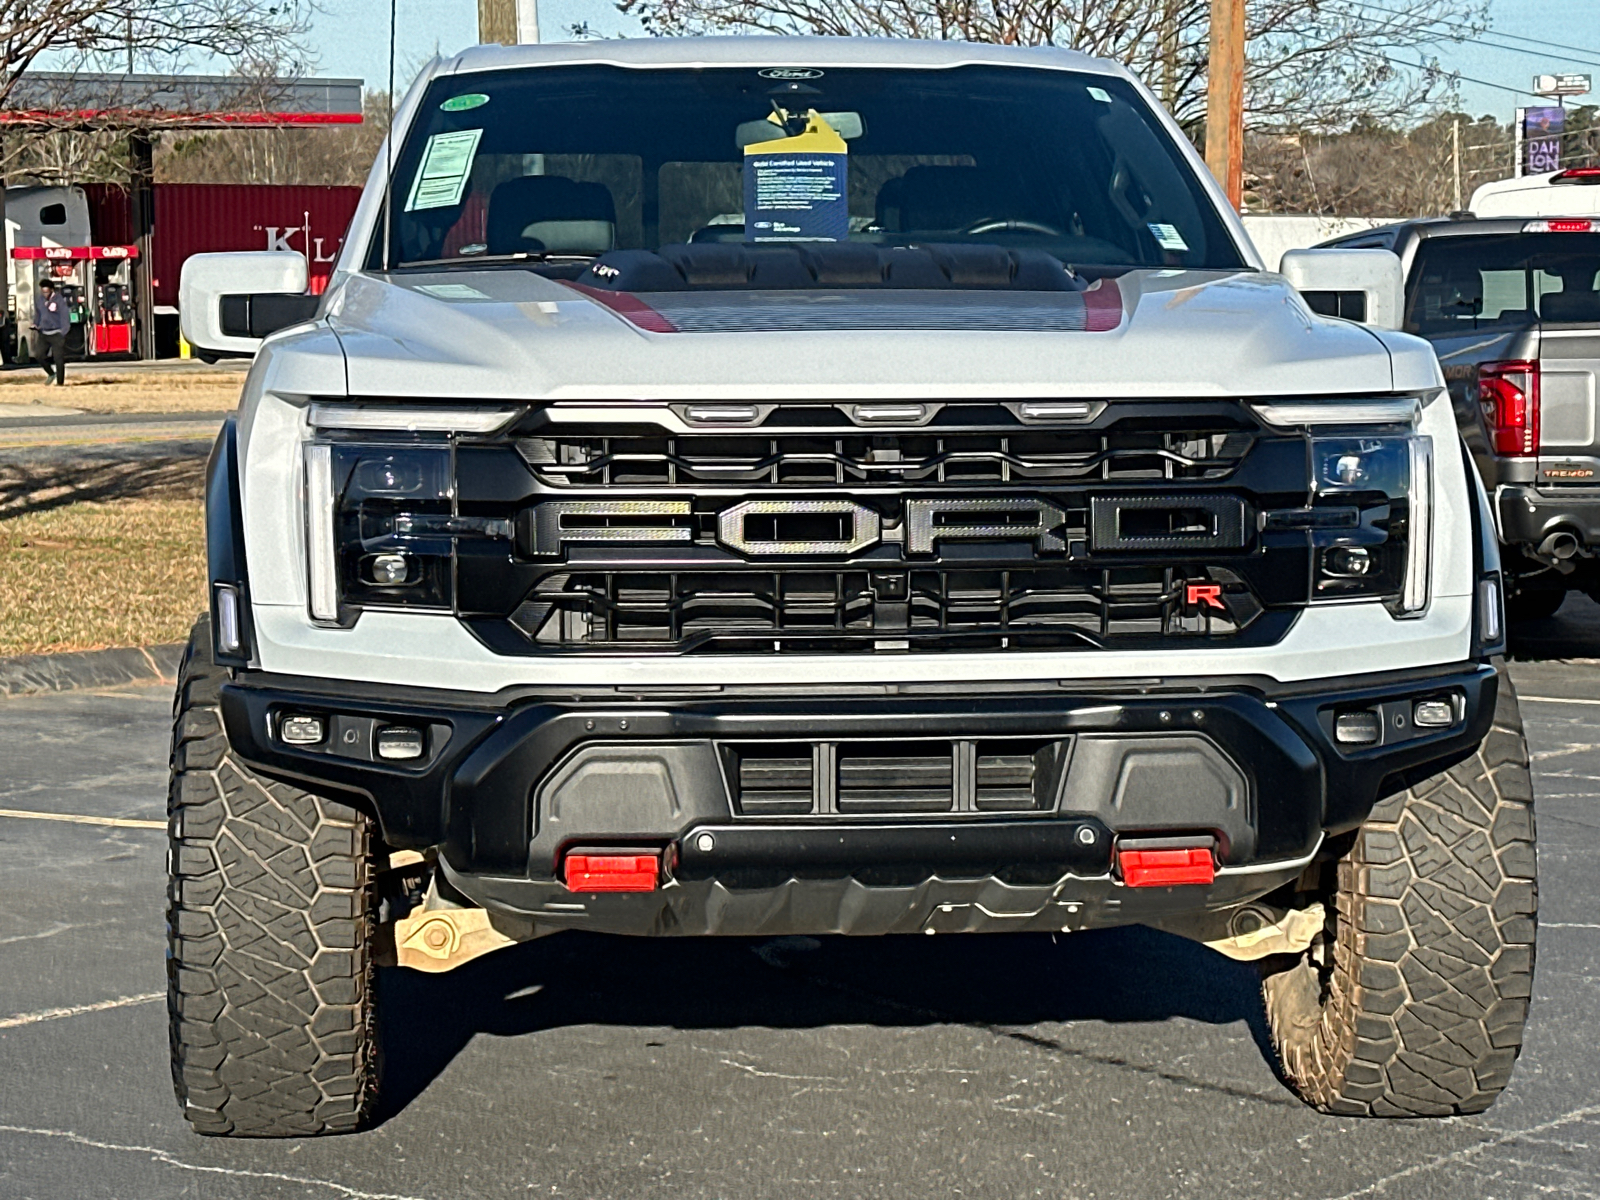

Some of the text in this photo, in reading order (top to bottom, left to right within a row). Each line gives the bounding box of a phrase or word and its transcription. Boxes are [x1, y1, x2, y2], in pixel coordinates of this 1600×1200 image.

[1530, 140, 1560, 154] DAH
[1530, 154, 1560, 173] LON
[313, 237, 343, 262] L
[531, 496, 1246, 556] FORD
[1187, 585, 1226, 610] R
